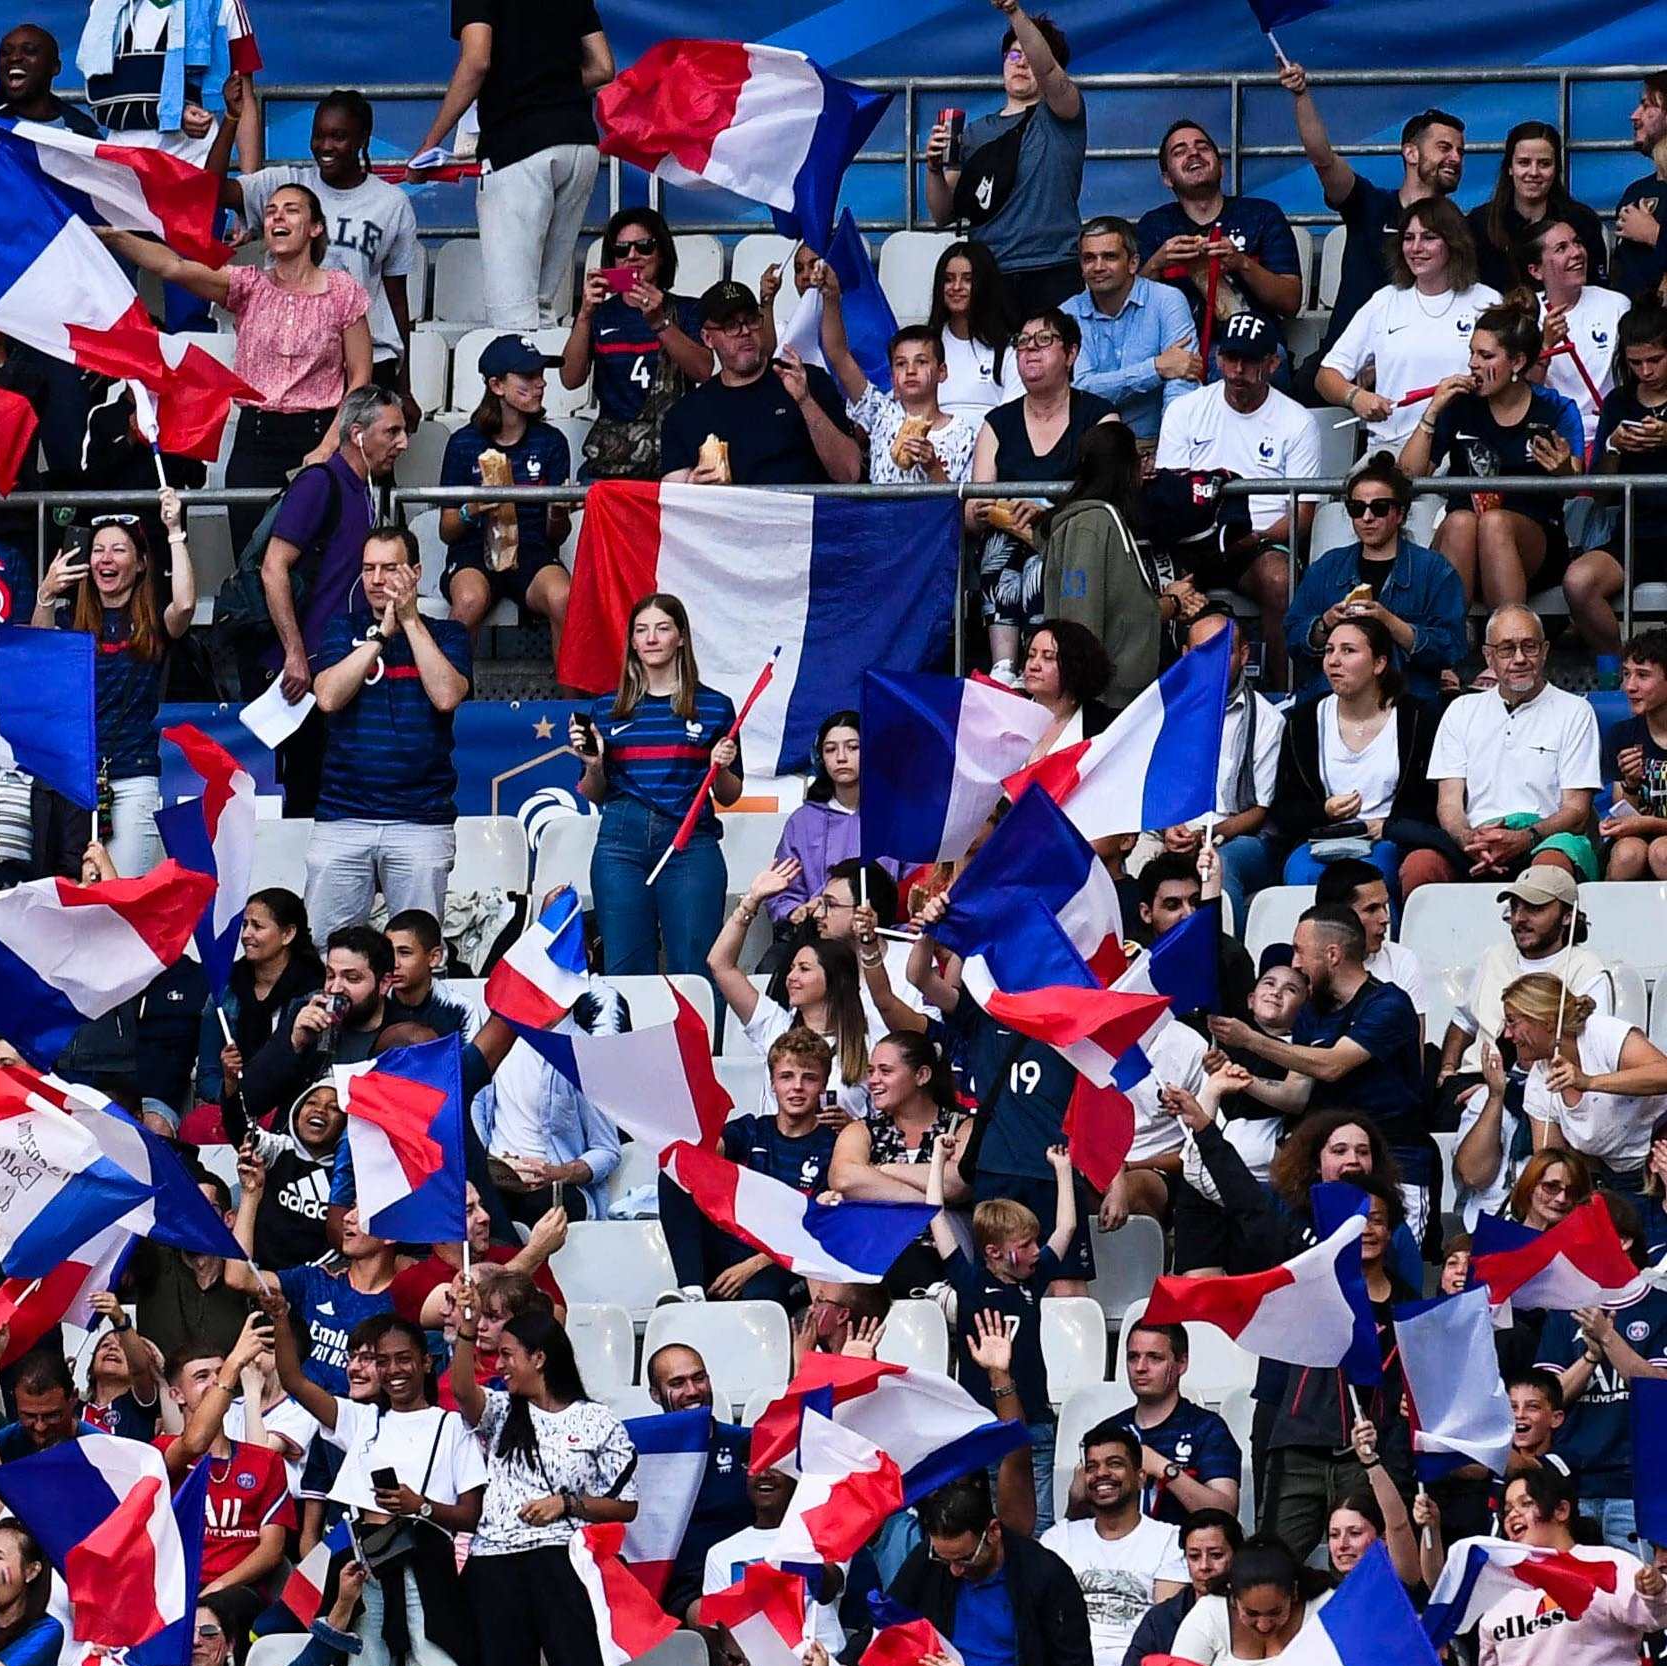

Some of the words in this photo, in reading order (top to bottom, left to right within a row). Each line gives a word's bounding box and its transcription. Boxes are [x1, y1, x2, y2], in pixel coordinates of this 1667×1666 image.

[1227, 314, 1266, 340] FFF
[630, 355, 651, 389] 4
[1009, 1059, 1042, 1095] 19
[278, 1188, 330, 1221] adida
